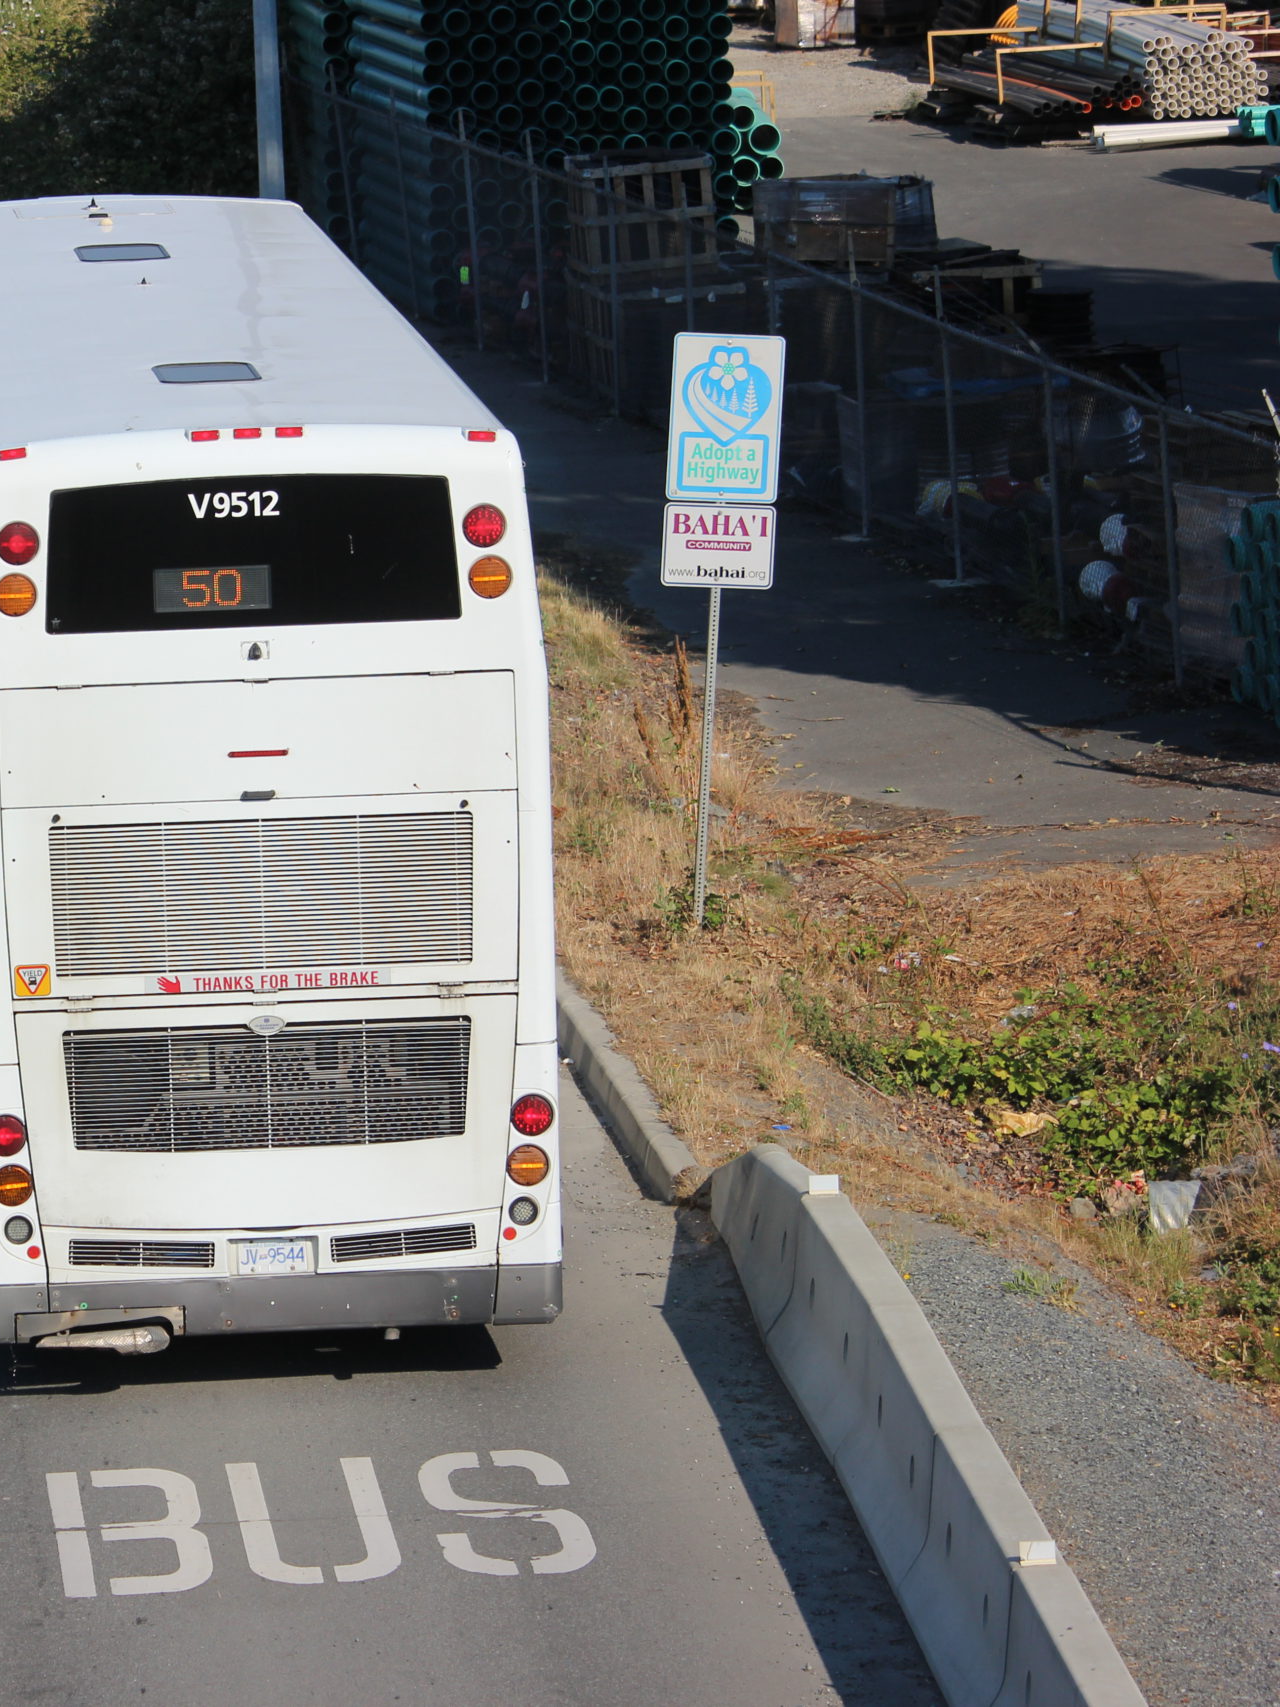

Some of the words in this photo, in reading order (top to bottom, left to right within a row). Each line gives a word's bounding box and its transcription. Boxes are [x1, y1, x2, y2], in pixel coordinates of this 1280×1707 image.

[691, 443, 743, 464] Adopt
[746, 448, 756, 461] a
[687, 461, 760, 485] Highway
[187, 490, 280, 519] V9512
[672, 513, 768, 537] BAHA'I
[687, 541, 751, 551] COMMUNITY
[668, 565, 766, 580] www.bahai.org
[182, 569, 242, 608] 50
[22, 969, 43, 977] YIELD
[193, 975, 254, 991] THANKS
[261, 974, 289, 989] FOR
[295, 972, 323, 987] THE
[329, 970, 379, 986] BRAKE
[45, 1449, 597, 1598] BUS
